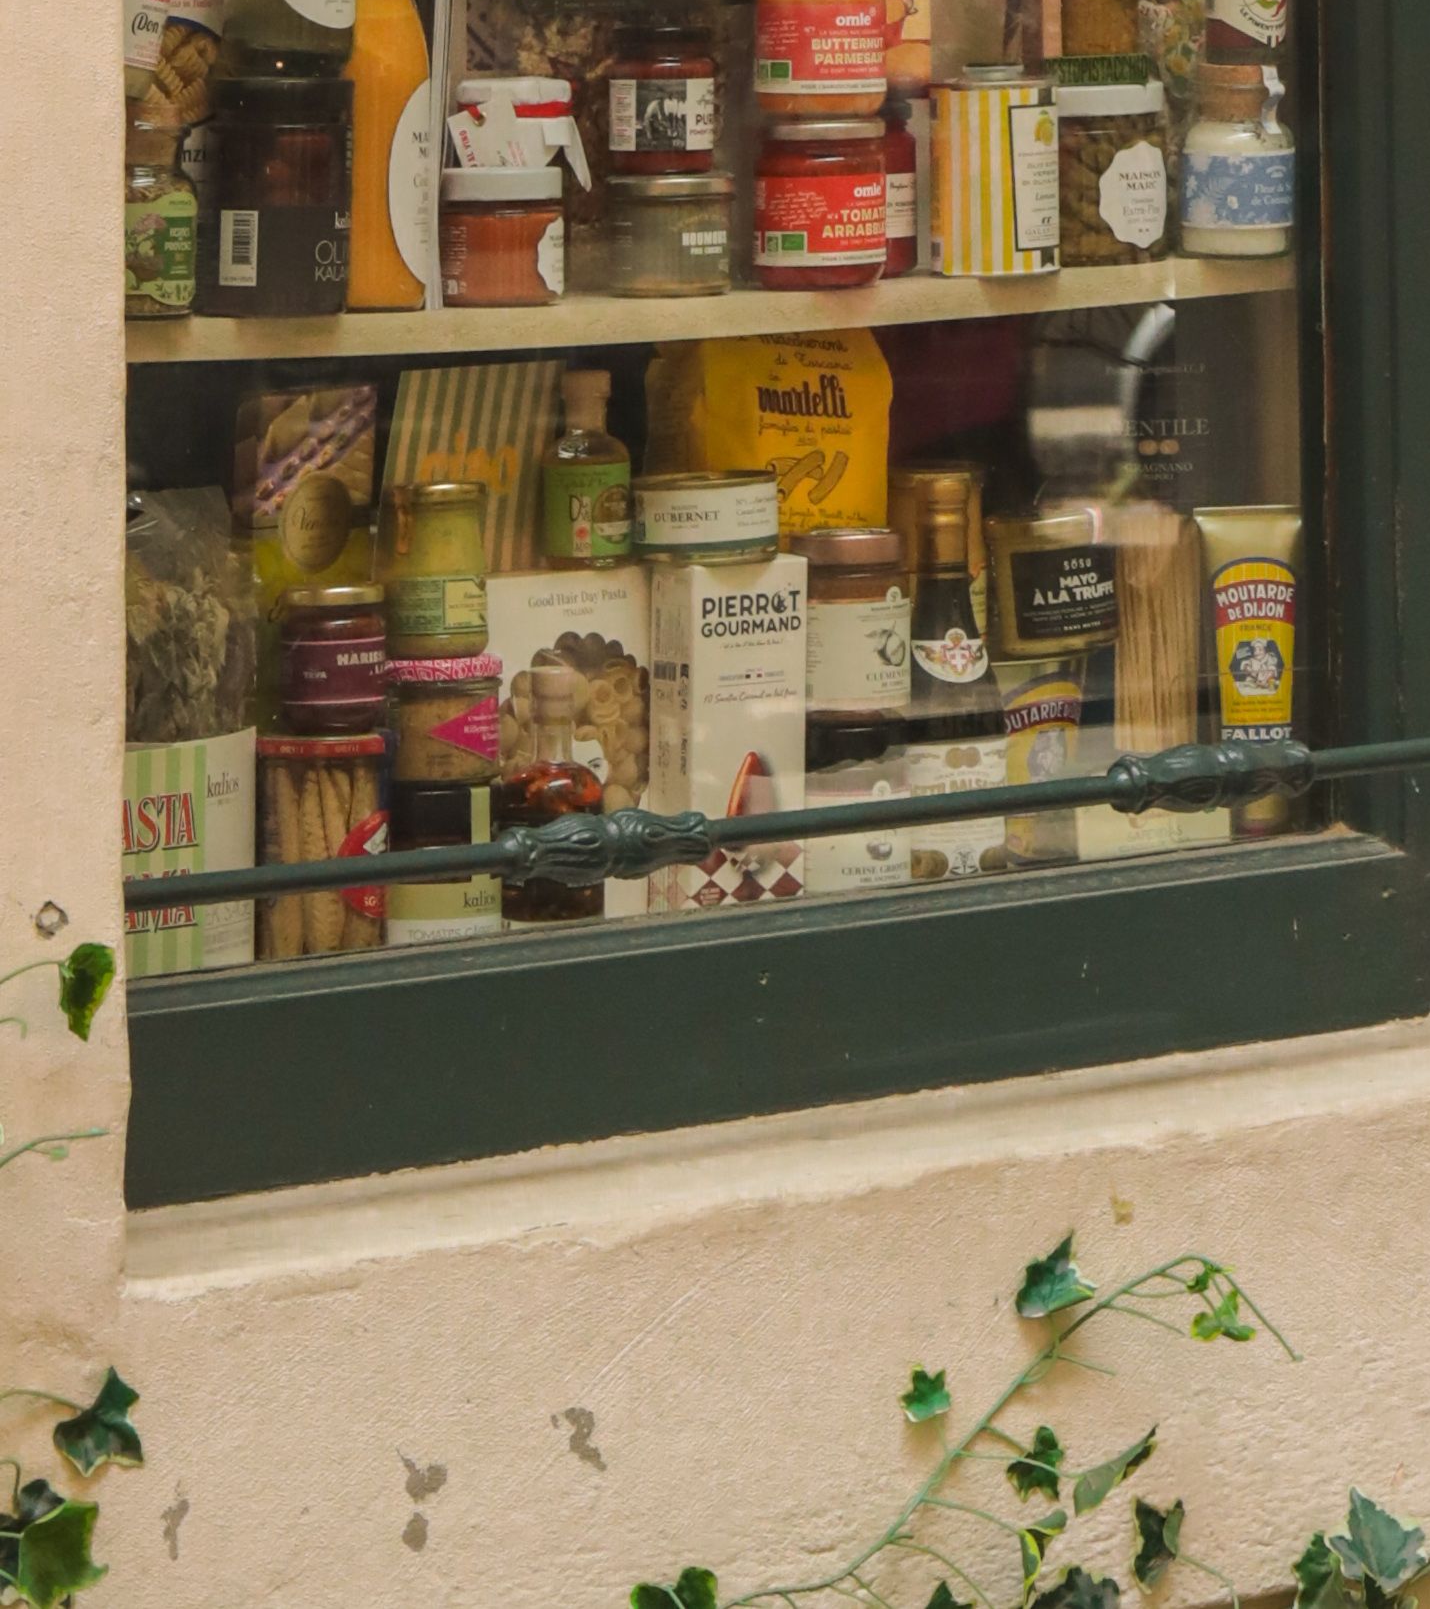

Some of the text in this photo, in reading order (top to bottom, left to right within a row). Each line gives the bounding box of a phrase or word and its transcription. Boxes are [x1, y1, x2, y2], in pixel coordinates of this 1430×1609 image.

[811, 36, 884, 51] BUTTERNUT
[1119, 172, 1161, 182] MAISON
[1126, 181, 1158, 191] MARC
[755, 374, 853, 419] martelli
[653, 509, 719, 523] DUBERNET
[1059, 572, 1098, 589] MAYO
[528, 586, 628, 609] Good Hair Day Pasta
[701, 588, 801, 620] PIERROT
[1032, 588, 1046, 606] À
[1047, 589, 1070, 605] LA
[1215, 583, 1295, 607] MOUTARDE
[1227, 601, 1286, 621] DE DIJON
[701, 614, 802, 639] GOURMAND
[1220, 726, 1293, 741] FALLOT
